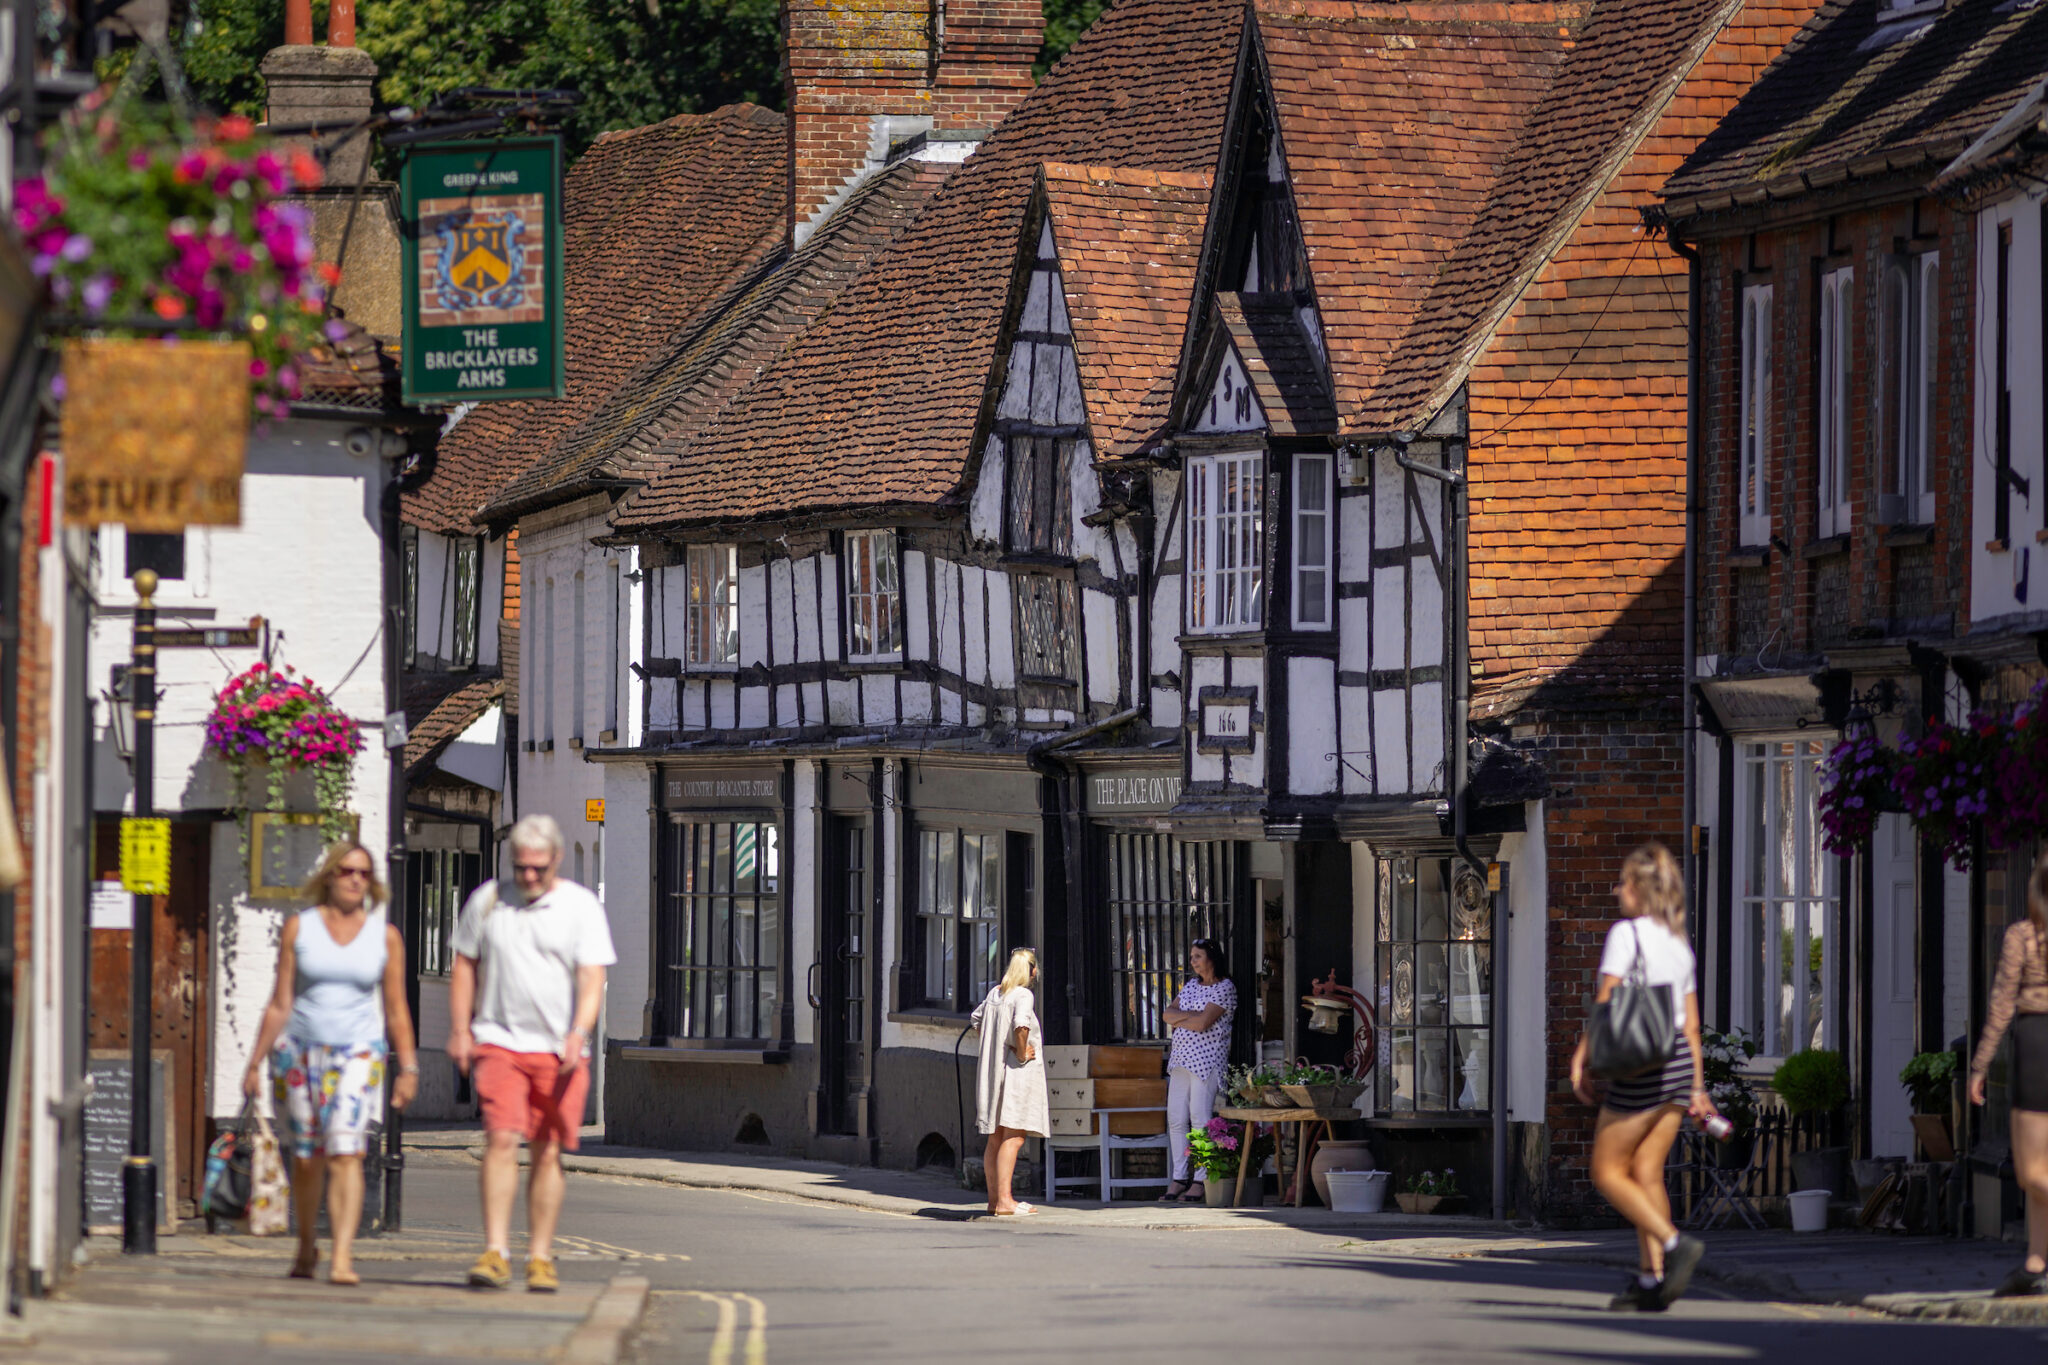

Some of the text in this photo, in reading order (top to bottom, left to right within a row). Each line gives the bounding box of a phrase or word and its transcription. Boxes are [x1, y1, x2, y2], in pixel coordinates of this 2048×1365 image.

[489, 171, 519, 184] KING
[462, 329, 498, 347] THE
[425, 348, 538, 369] BRICKLAYERS
[457, 370, 506, 388] ARMS
[1218, 709, 1236, 733] 1660
[668, 780, 774, 797] THE COUNTRY BROCANTE STORE
[1095, 779, 1115, 804] THE
[1118, 778, 1147, 804] PLACE
[1149, 777, 1165, 804] ON
